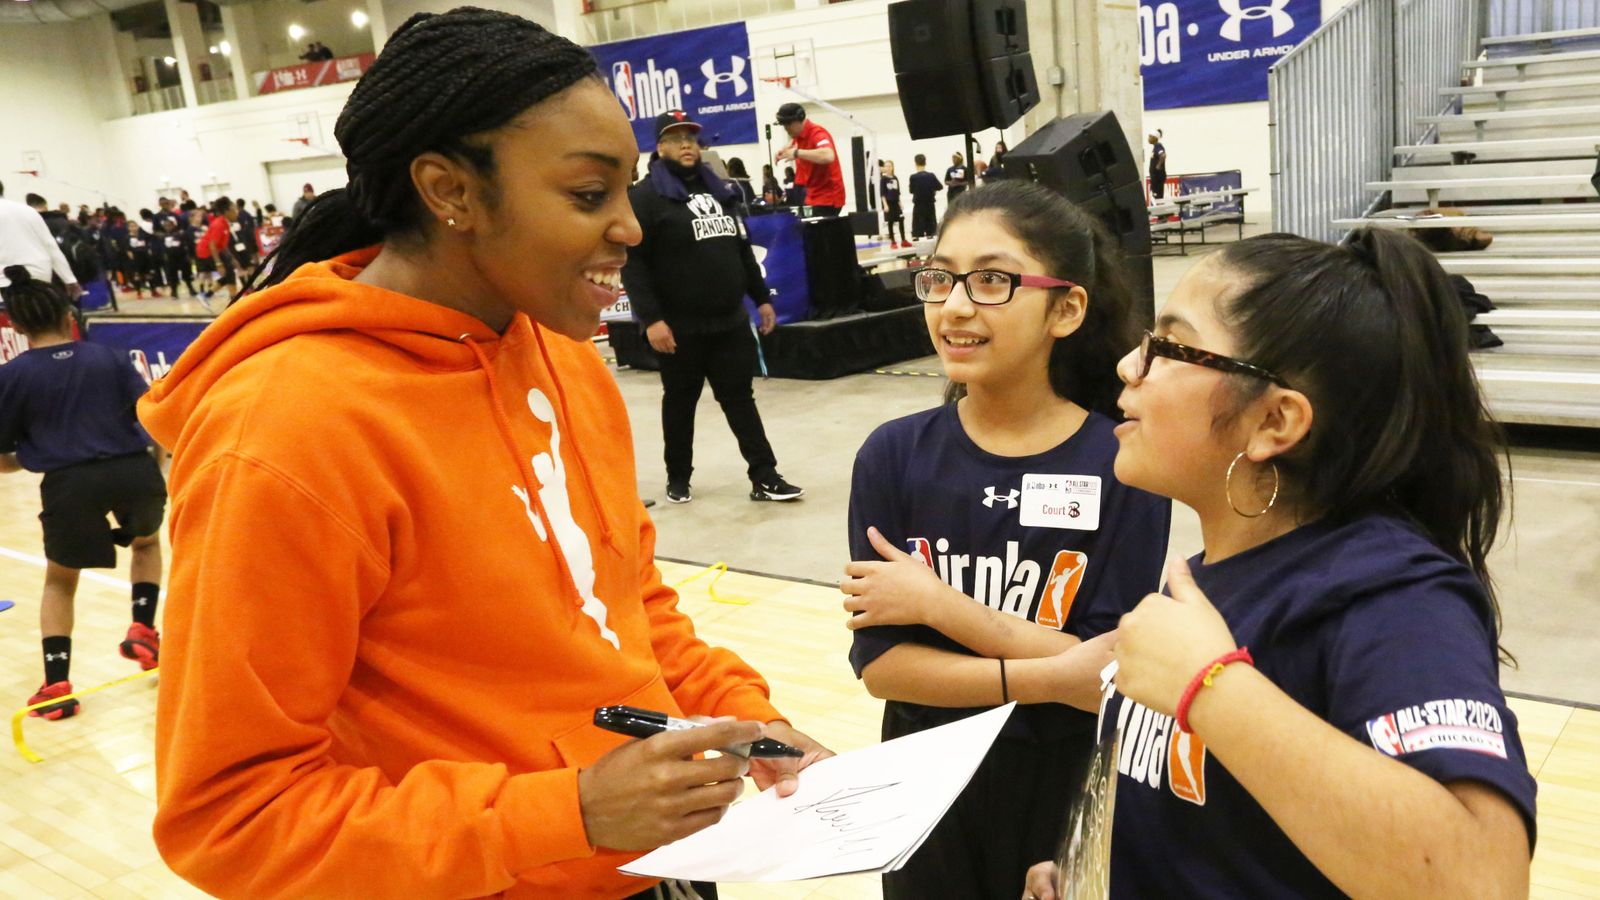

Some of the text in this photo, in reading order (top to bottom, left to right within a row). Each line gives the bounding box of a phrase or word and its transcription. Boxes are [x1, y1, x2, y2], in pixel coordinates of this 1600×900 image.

[1207, 48, 1250, 63] UNDER
[634, 58, 683, 119] nba
[698, 105, 724, 115] UNDER
[693, 216, 736, 239] PANDAS
[1042, 504, 1065, 516] Court
[1429, 734, 1484, 744] CHICAGO
